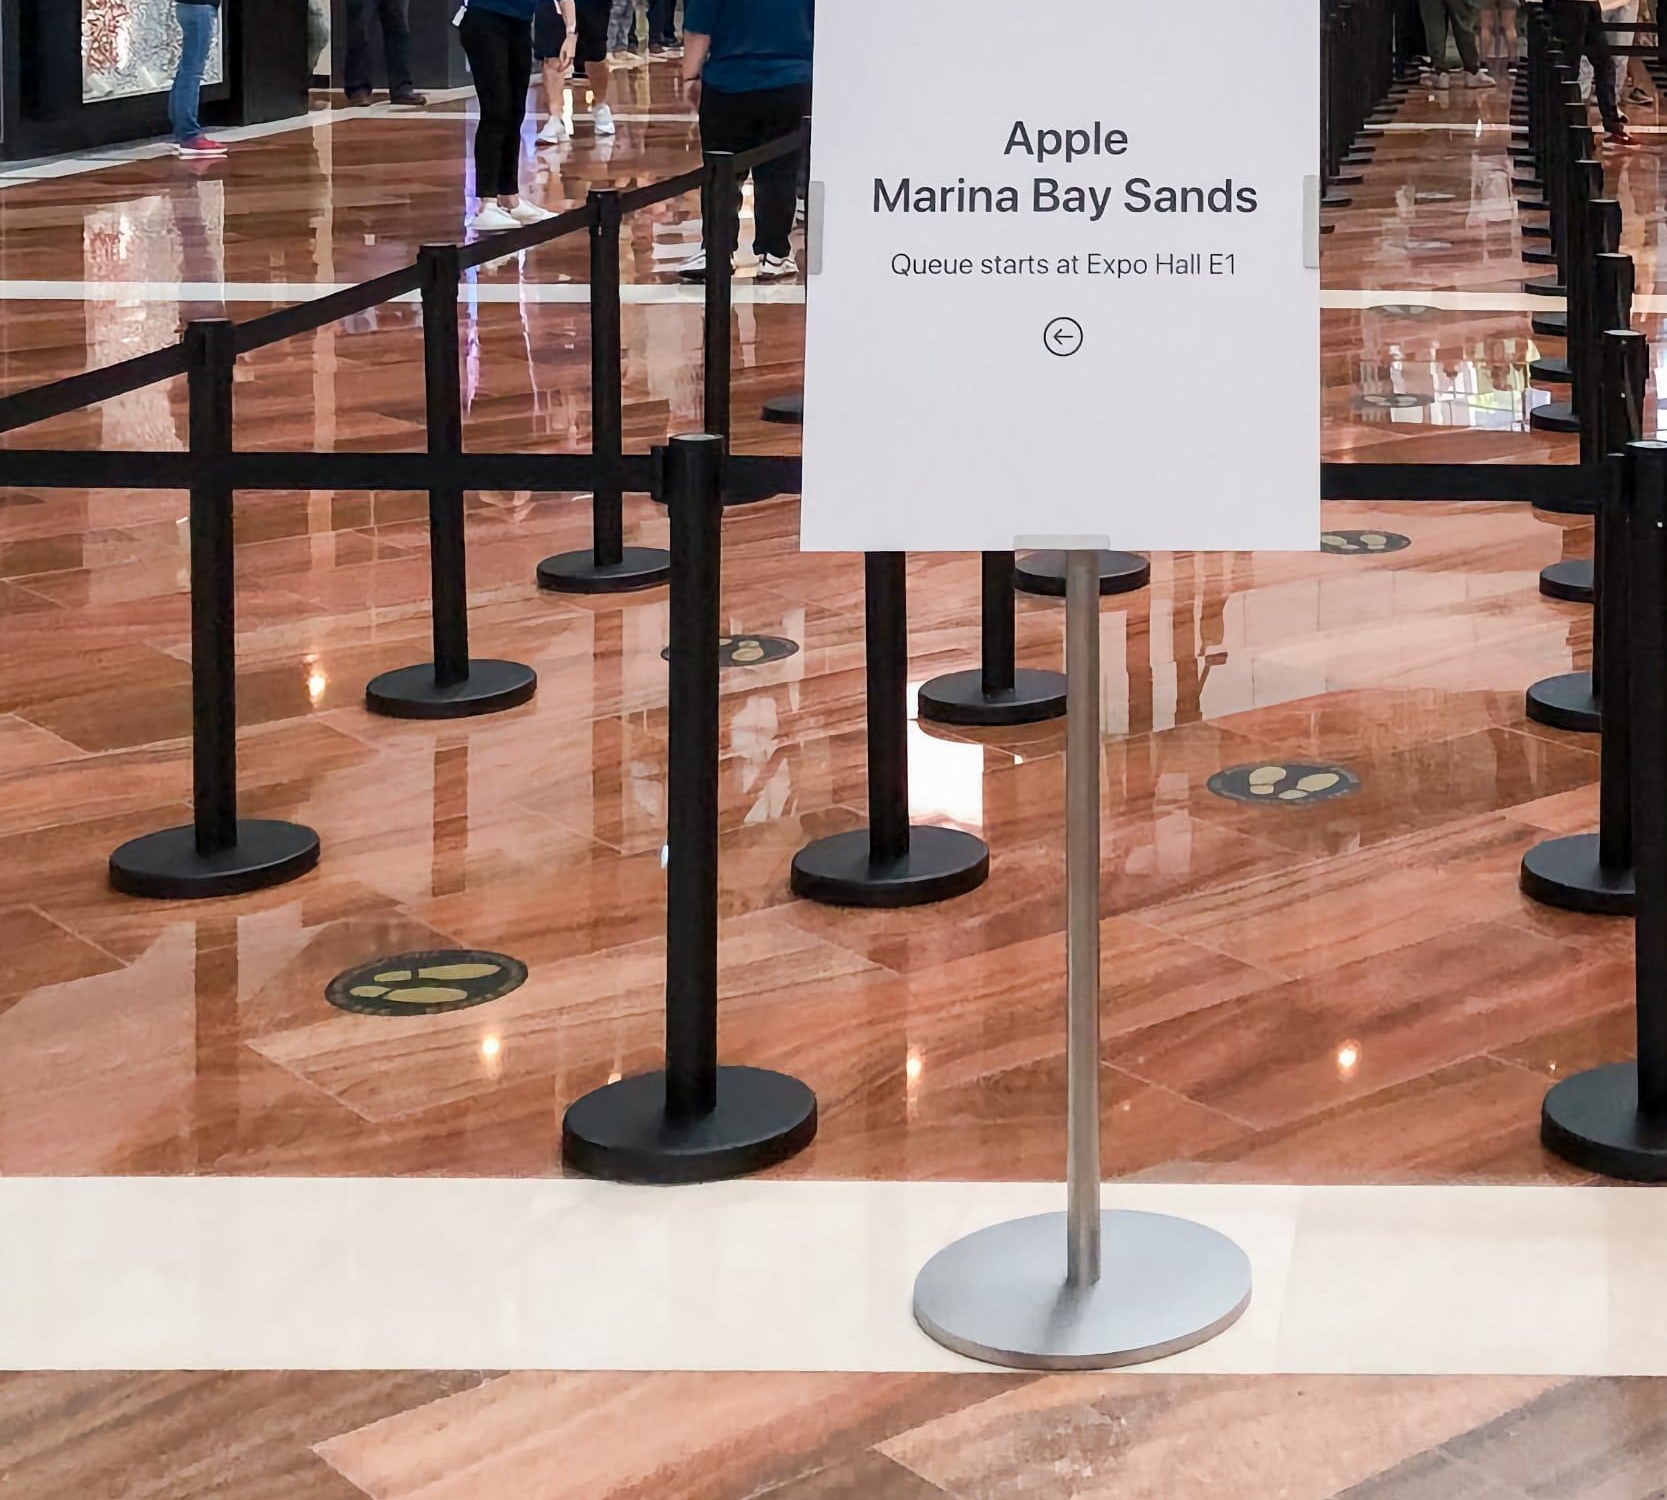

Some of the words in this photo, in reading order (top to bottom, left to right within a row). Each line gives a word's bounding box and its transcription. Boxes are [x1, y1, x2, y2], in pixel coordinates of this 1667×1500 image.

[1003, 120, 1129, 163] Apple
[872, 177, 1018, 213] Marina
[1032, 177, 1112, 221] Bay
[1124, 177, 1258, 213] Sands
[891, 253, 974, 277] Queue
[980, 254, 1048, 275] starts
[1056, 255, 1080, 275] at
[1087, 253, 1148, 279] Expo
[1155, 253, 1201, 275] Hall
[1209, 253, 1236, 275] E1
